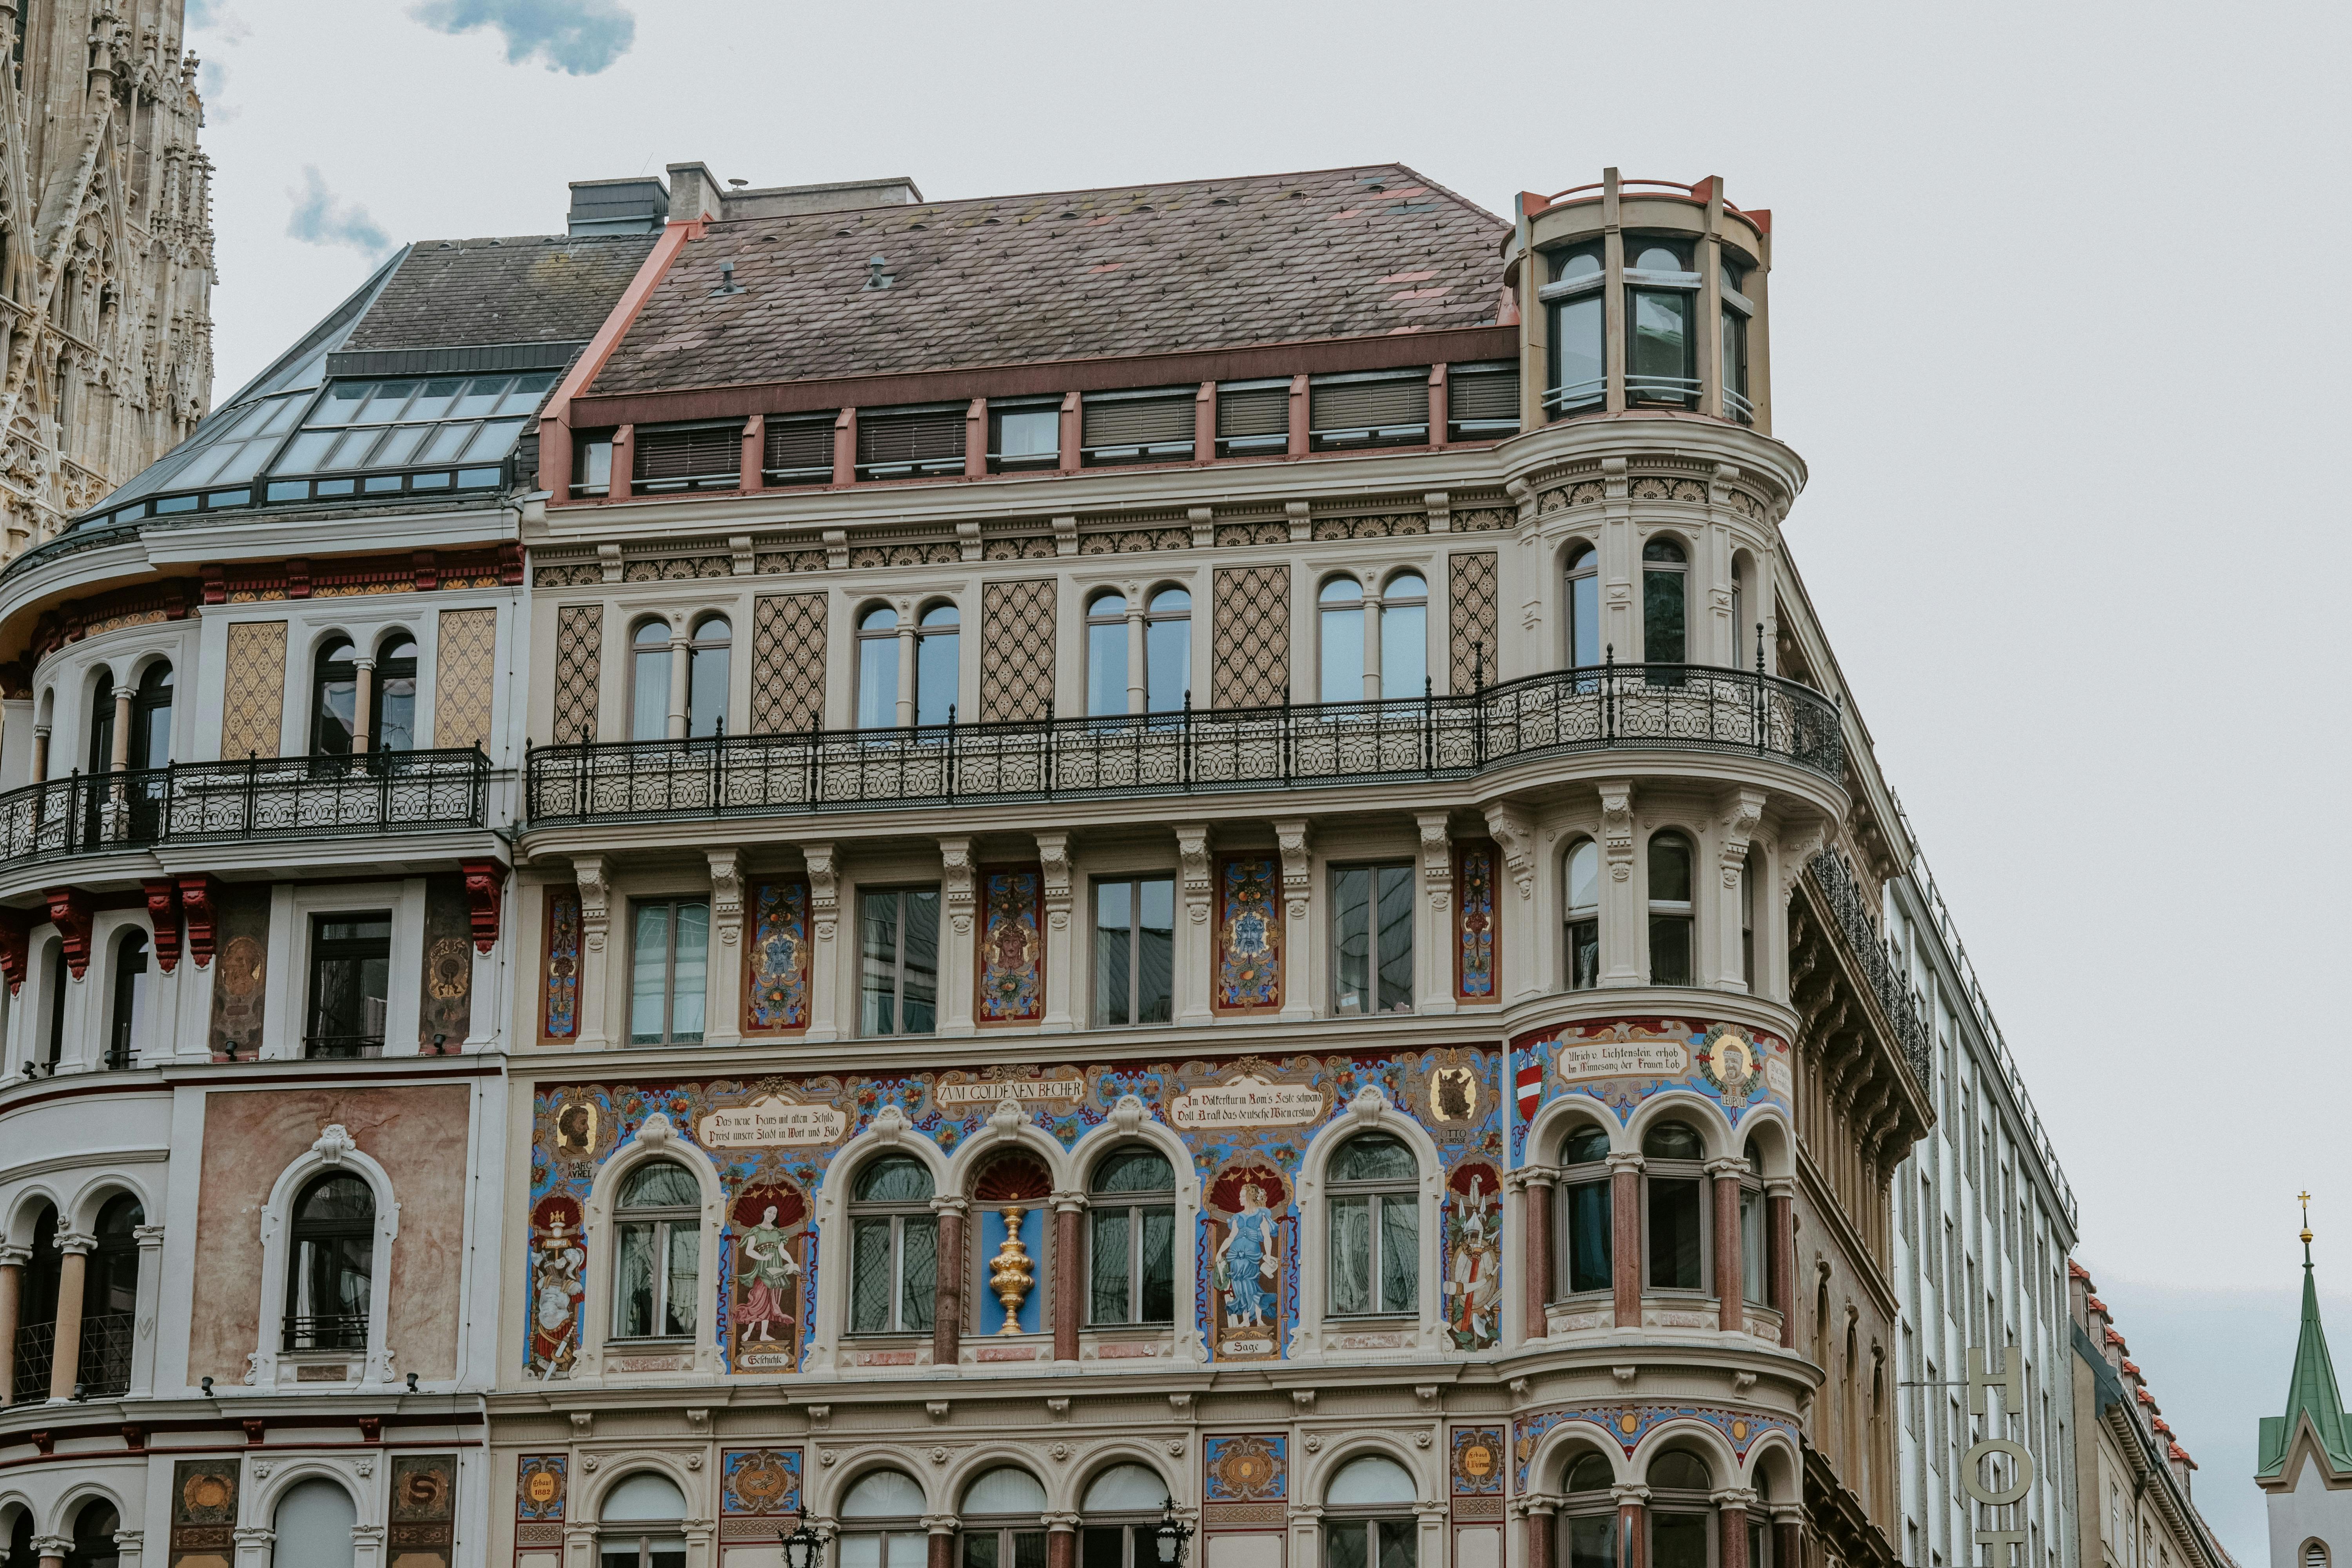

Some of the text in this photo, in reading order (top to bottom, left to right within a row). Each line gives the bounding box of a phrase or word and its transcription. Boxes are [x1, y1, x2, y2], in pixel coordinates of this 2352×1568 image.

[1569, 1051, 1590, 1063] Ulrich
[1602, 1047, 1651, 1060] Lichtenstein
[1656, 1047, 1678, 1058] erhob
[1568, 1058, 1680, 1073] Im Minnesang der Frauen Lob
[940, 1082, 1081, 1100] ZVM GOLDENEN BECHER
[1296, 1092, 1322, 1104] schwand
[1722, 1095, 1746, 1107] LEOPOLD
[715, 1111, 834, 1127] Das neue Haus mit altem Schild
[1223, 1109, 1237, 1120] das
[1239, 1108, 1269, 1121] deutsche
[1270, 1107, 1291, 1118] Wien
[1292, 1106, 1316, 1117] erstand
[709, 1126, 839, 1144] Preist unsere Stadt in Wort und Bild
[1441, 1129, 1466, 1138] OTTO
[568, 1161, 592, 1170] MARC
[567, 1169, 592, 1179] AVREL
[1234, 1342, 1259, 1352] Sage
